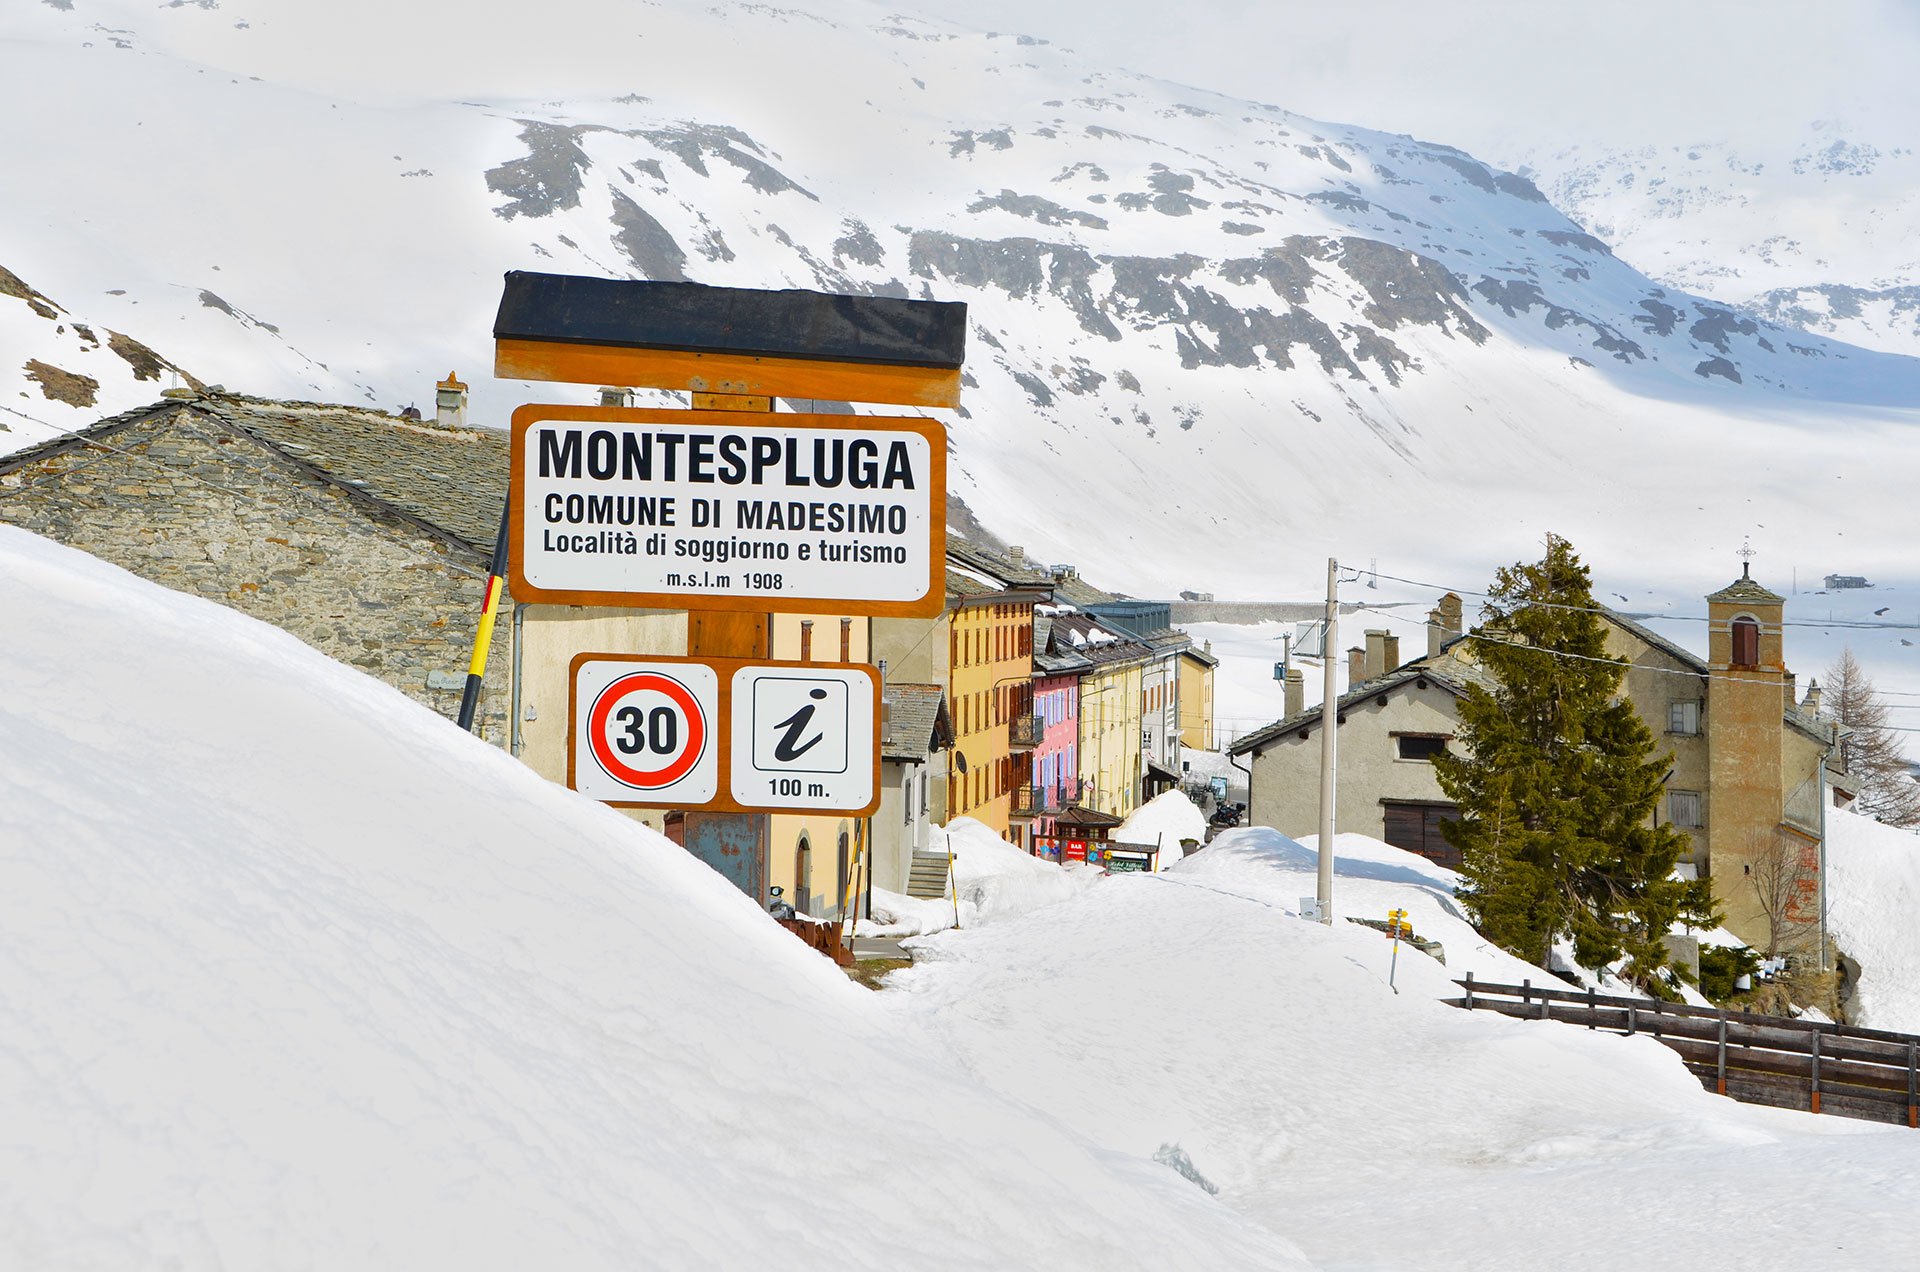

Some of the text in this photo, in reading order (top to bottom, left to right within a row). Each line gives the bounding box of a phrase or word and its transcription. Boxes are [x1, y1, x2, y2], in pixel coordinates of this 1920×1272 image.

[538, 430, 916, 490] MONTESPLUGA
[544, 493, 906, 535] COMUNE DI MADESIMO
[544, 530, 907, 564] Località di soggiorno e turismo
[666, 572, 783, 590] m.s.l.m 1908
[616, 706, 677, 755] 30
[768, 779, 831, 798] 100 m.
